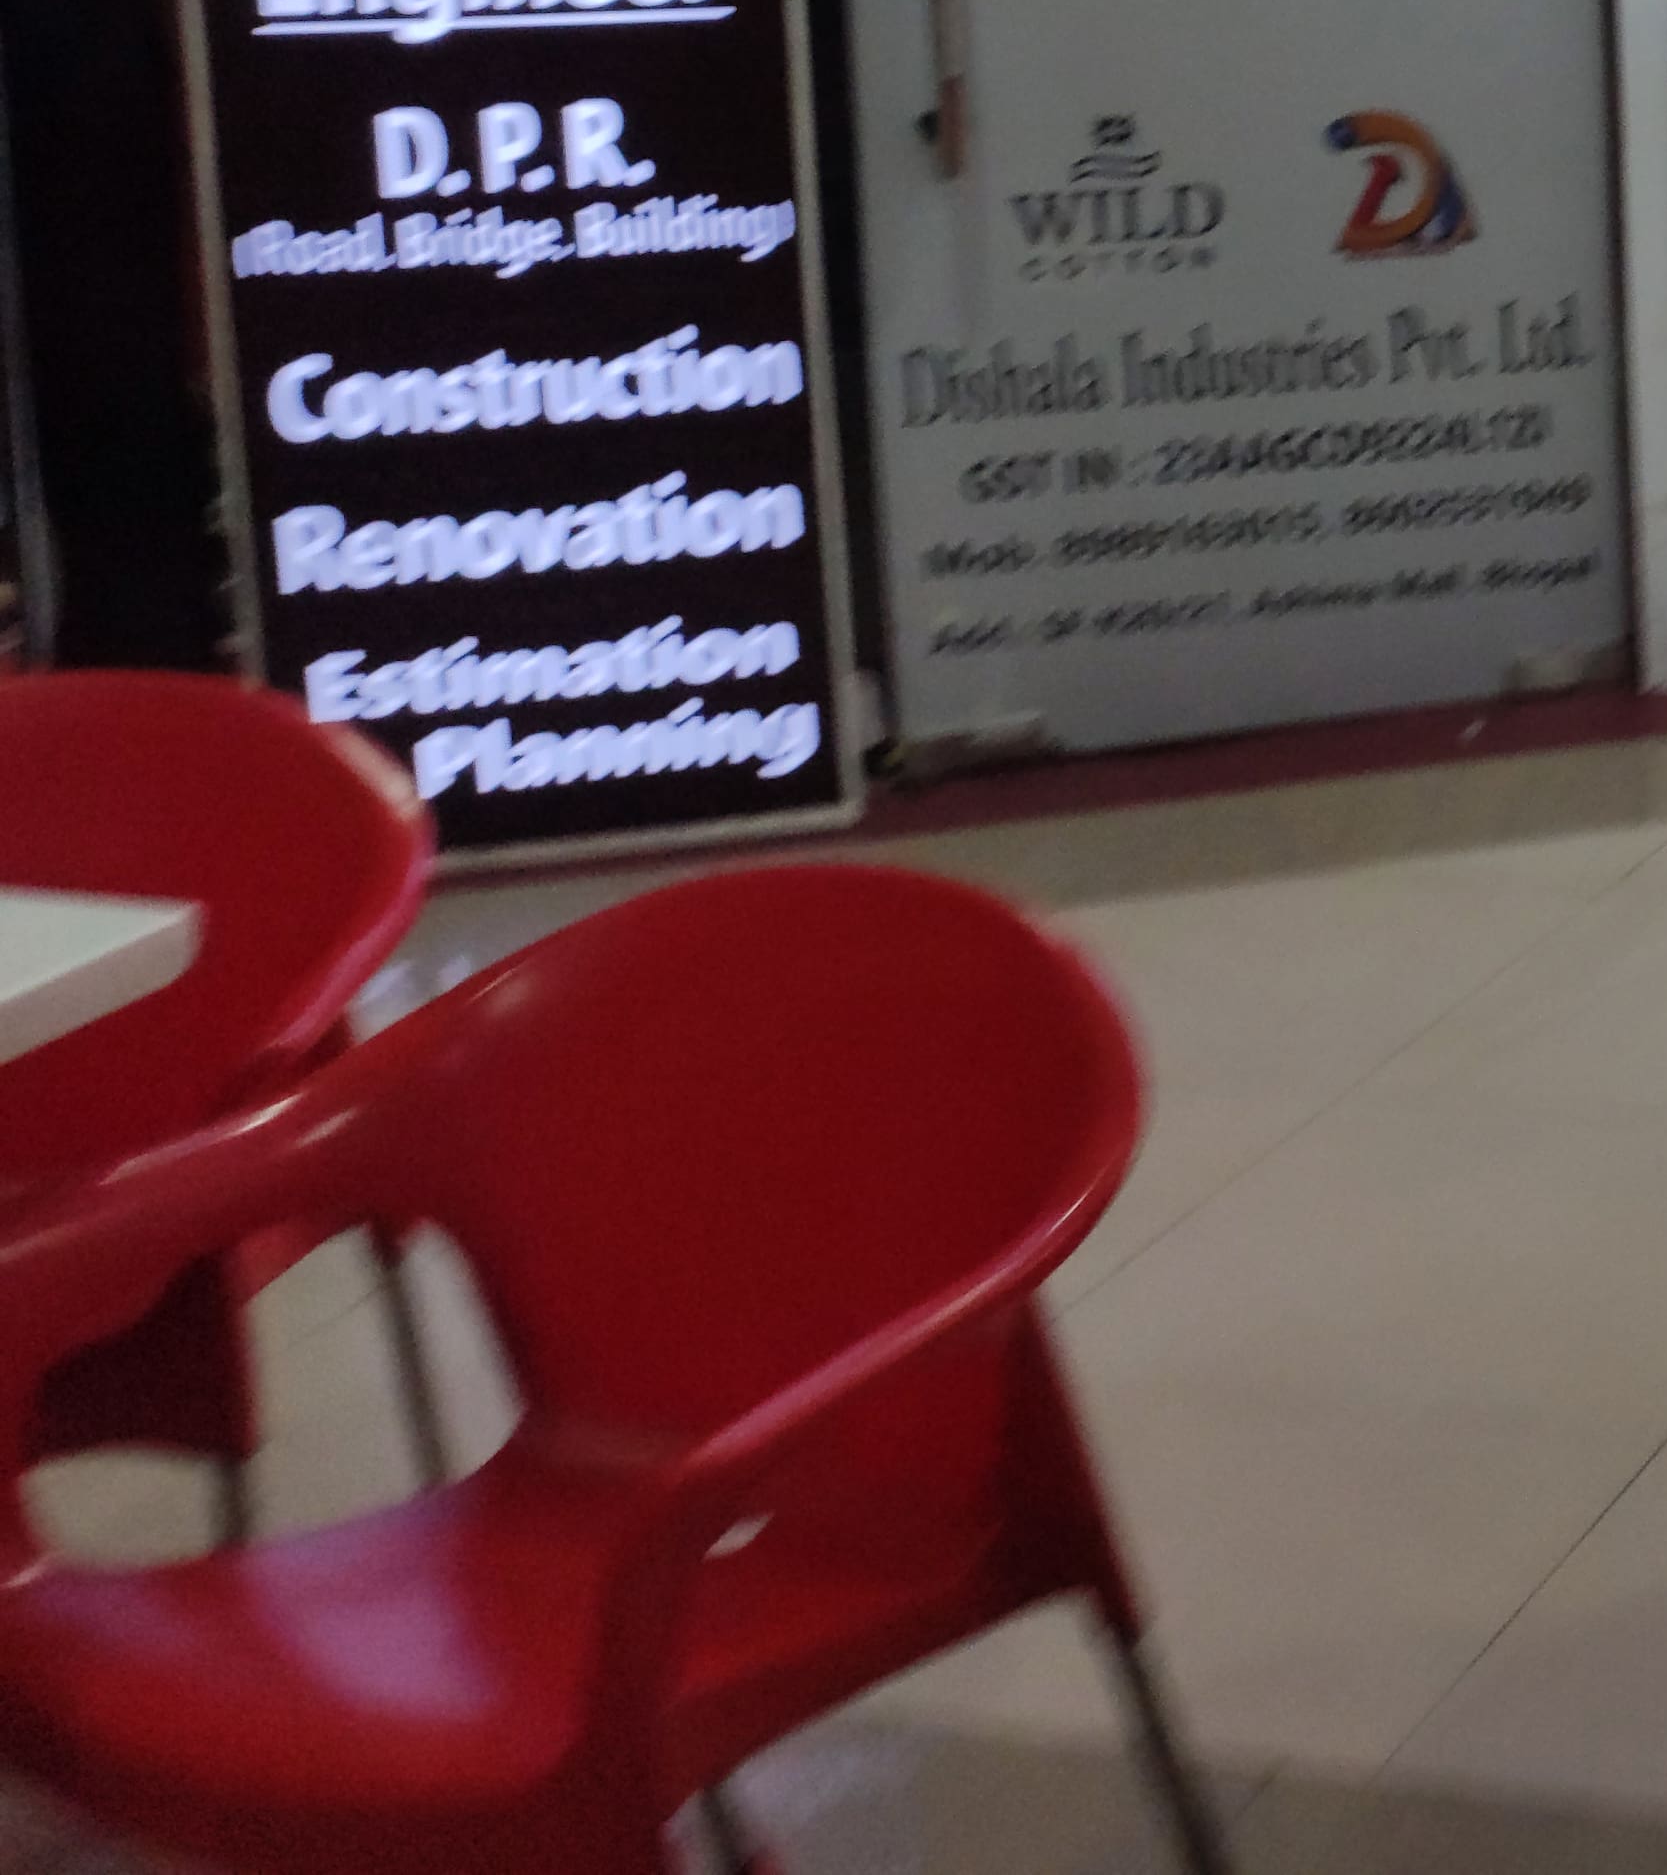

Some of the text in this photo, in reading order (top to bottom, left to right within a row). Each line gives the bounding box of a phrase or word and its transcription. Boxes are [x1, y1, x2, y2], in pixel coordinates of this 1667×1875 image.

[1008, 179, 1228, 246] WILD
[268, 325, 802, 443] Construction
[900, 328, 1110, 425] Dishala
[1120, 319, 1378, 409] Industries
[273, 471, 804, 594] Renovation
[305, 615, 799, 723] Estimation
[413, 698, 820, 799] Planning
